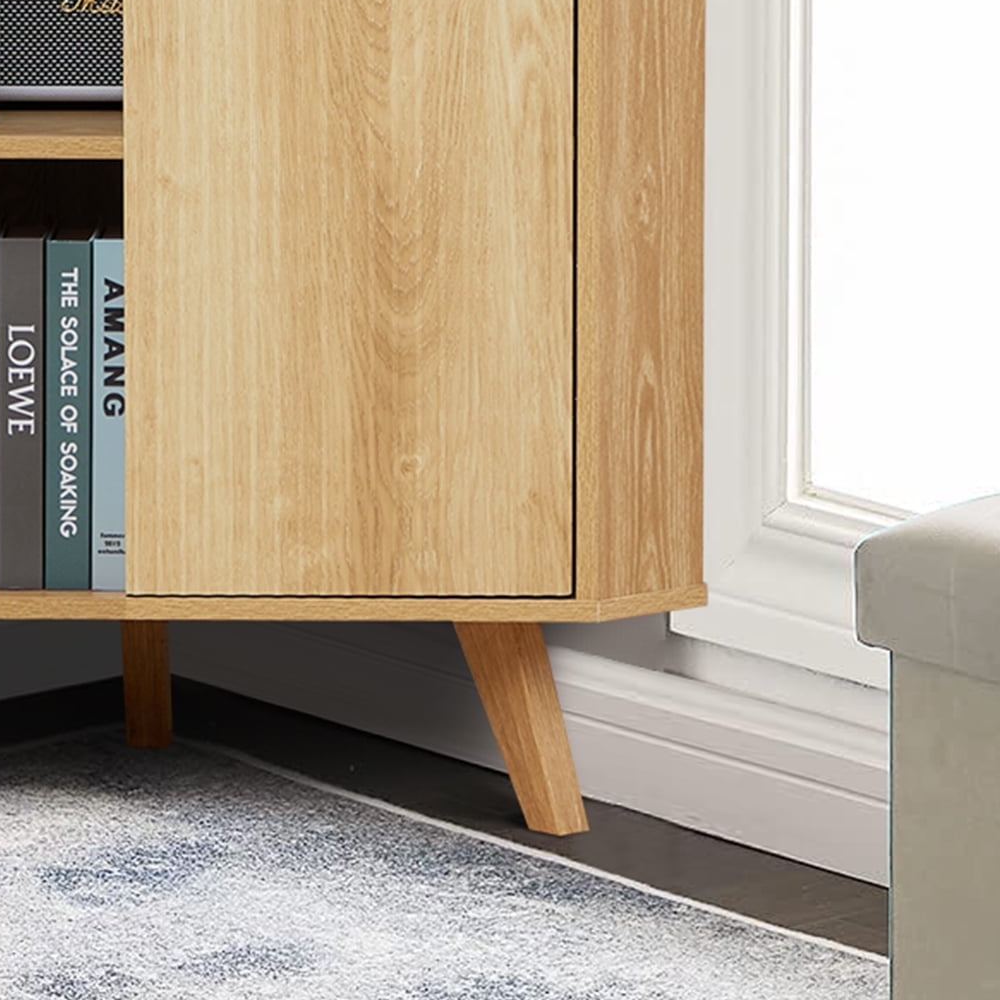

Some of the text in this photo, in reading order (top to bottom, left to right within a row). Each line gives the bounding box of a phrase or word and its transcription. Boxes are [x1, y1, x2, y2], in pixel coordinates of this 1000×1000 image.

[7, 324, 36, 436] LOEWE
[59, 266, 79, 539] THE SOLACE OF SOAKING
[103, 277, 125, 417] AMANG
